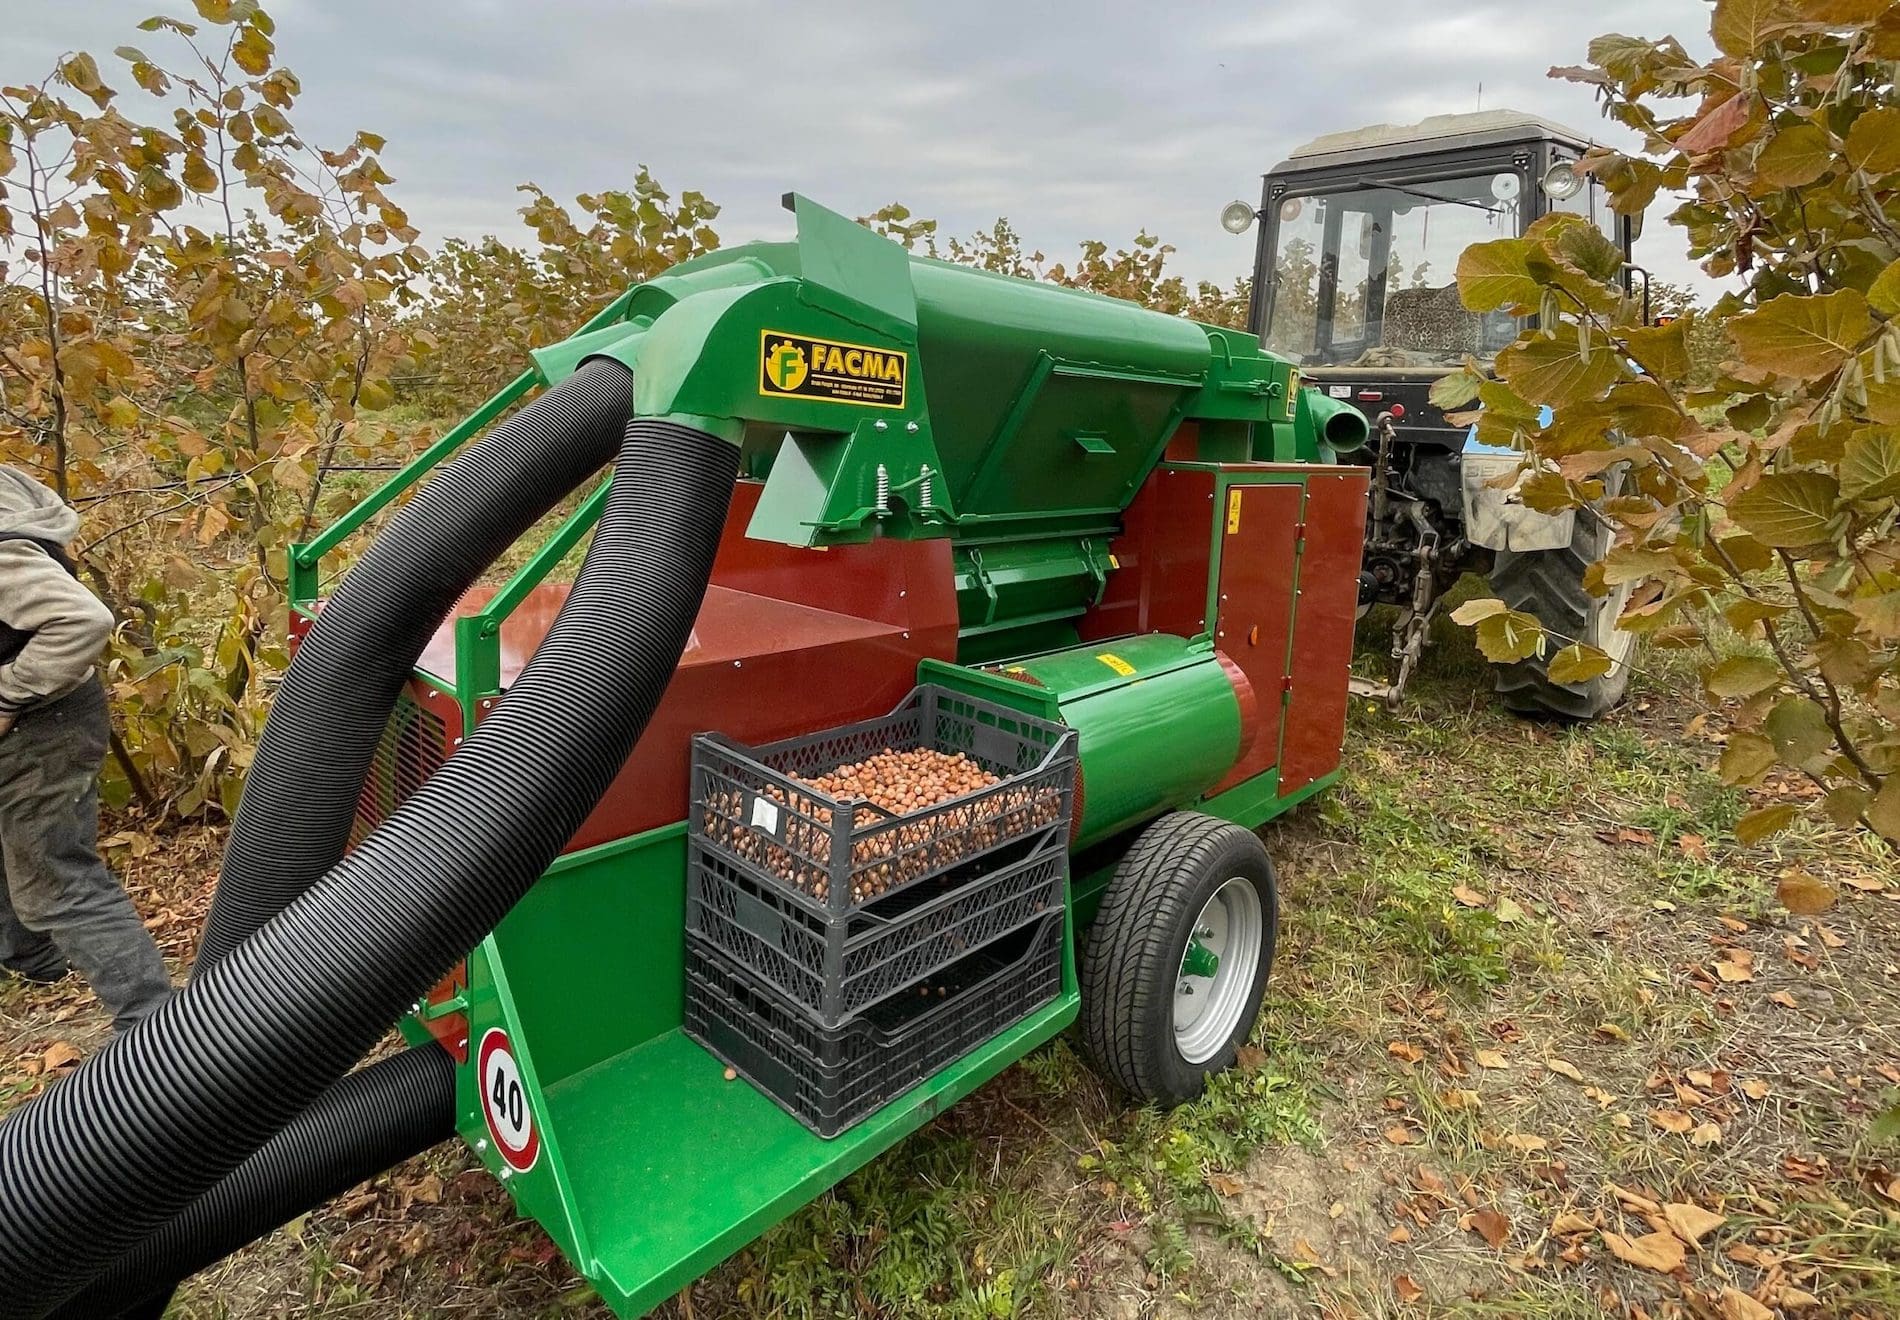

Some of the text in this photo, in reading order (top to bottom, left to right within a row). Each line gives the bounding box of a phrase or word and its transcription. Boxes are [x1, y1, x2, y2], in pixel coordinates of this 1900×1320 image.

[779, 351, 798, 388] F
[811, 344, 902, 381] FACMA
[493, 1067, 523, 1132] 40
